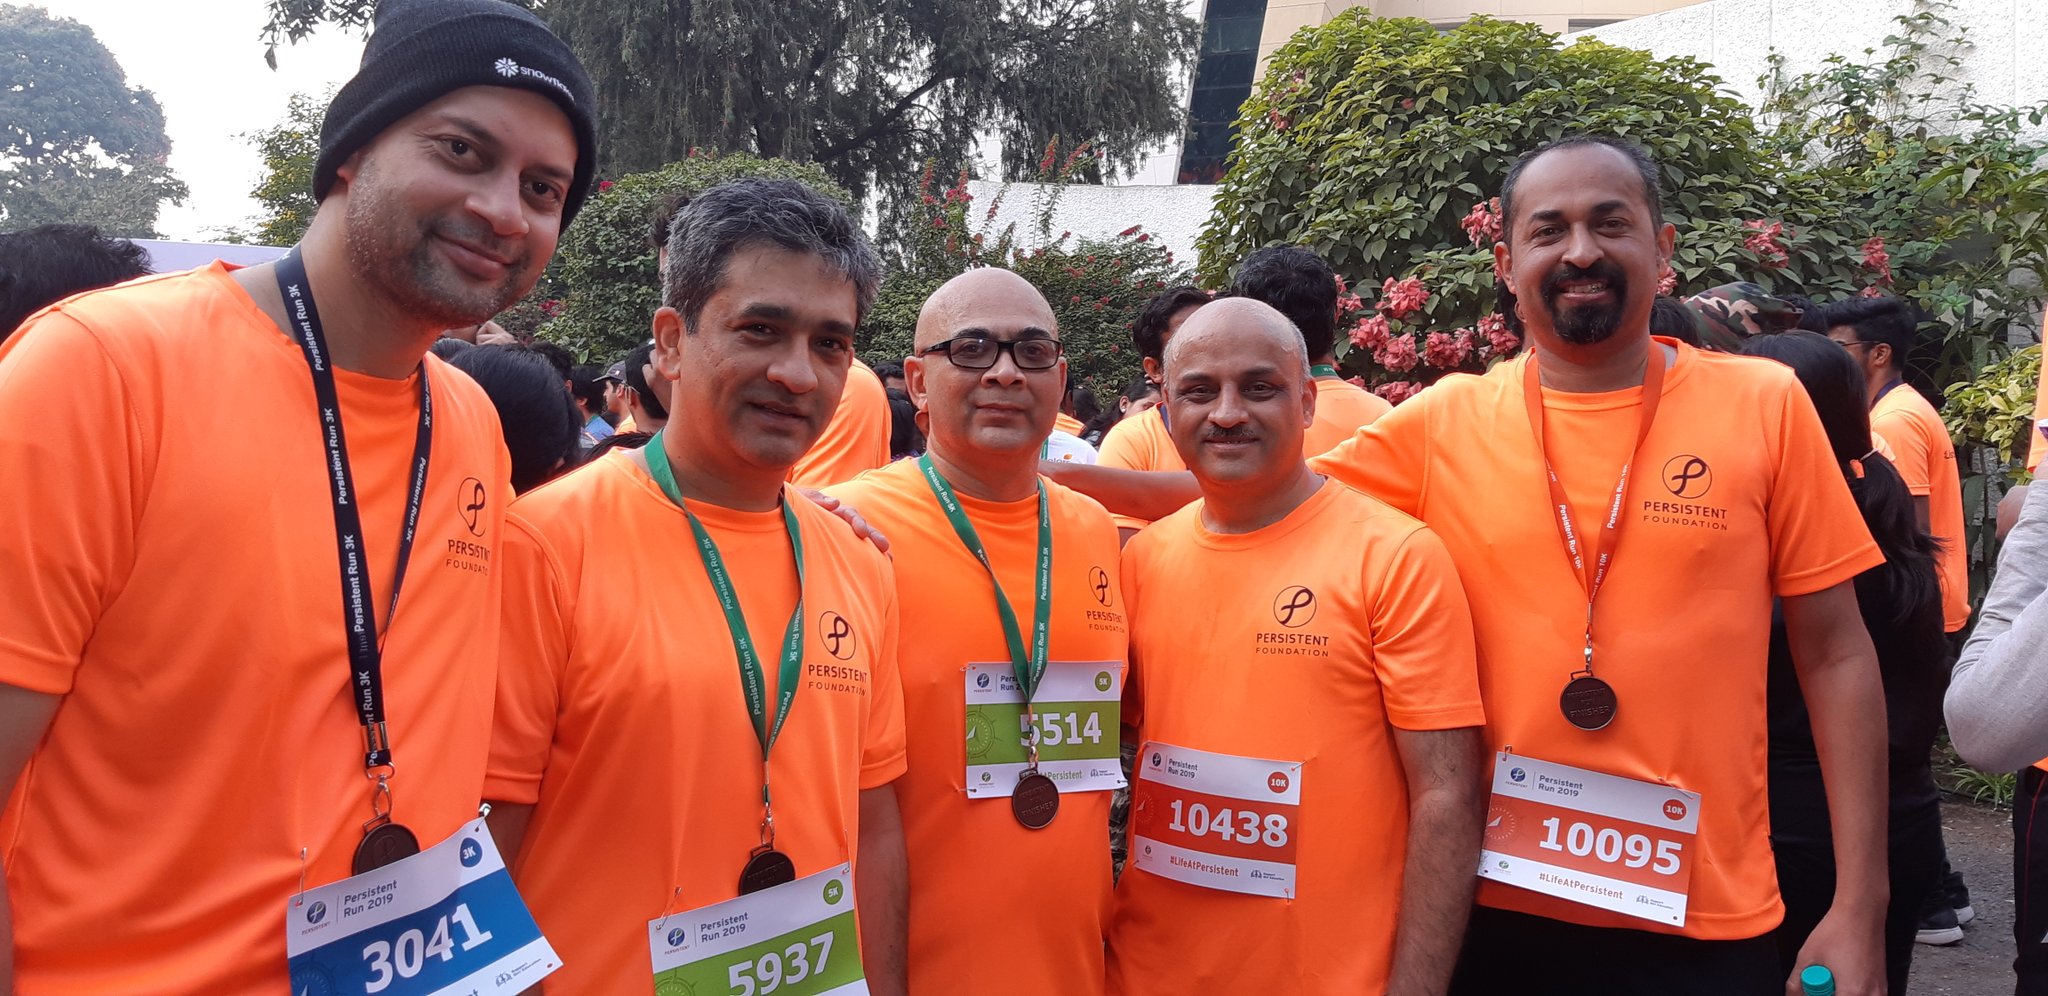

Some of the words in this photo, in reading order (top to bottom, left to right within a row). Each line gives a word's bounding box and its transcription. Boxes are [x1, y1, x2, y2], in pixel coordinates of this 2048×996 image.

[520, 66, 576, 105] snowfla
[287, 284, 301, 298] 3K
[297, 299, 310, 320] Run
[301, 321, 325, 371] Persistent
[325, 408, 336, 423] 3K
[328, 425, 339, 447] Run
[330, 448, 348, 505] Persistent
[412, 457, 427, 505] Persistent
[409, 505, 418, 526] Run
[1607, 492, 1622, 529] Persistent
[1644, 501, 1728, 519] PERSISTENT
[1559, 504, 1574, 540] Persistent
[1568, 539, 1577, 555] Run
[1643, 515, 1728, 531] FOUNDATION
[344, 534, 356, 551] 3K
[406, 527, 413, 543] 3K
[702, 538, 712, 549] 5K
[348, 552, 360, 576] Run
[709, 547, 719, 567] Run
[714, 565, 733, 610] Persistent
[352, 579, 365, 633] Persistent
[739, 637, 747, 650] 5K
[791, 633, 799, 650] Run
[1256, 633, 1329, 646] PERSISTENT
[743, 650, 753, 671] Run
[789, 651, 797, 662] 5K
[1255, 647, 1329, 657] FOUNDATION
[359, 671, 371, 686] 3K
[808, 664, 868, 683] PERSISTENT
[363, 688, 374, 711] Run
[746, 670, 761, 715] Persistent
[1020, 711, 1102, 747] 5514
[1168, 766, 1179, 775] Run
[1180, 769, 1196, 778] 2019
[1169, 758, 1198, 771] Persistent
[1271, 778, 1286, 787] 10K
[1538, 783, 1555, 793] Run
[1557, 787, 1579, 797] 2019
[1539, 775, 1583, 790] Persistent
[1666, 805, 1683, 815] 10K
[1169, 799, 1288, 847] 10438
[463, 846, 476, 859] 3K
[1539, 816, 1682, 875] 10095
[1170, 856, 1239, 877] #LifeAtPersistent
[344, 880, 397, 905] Persistent
[828, 887, 839, 897] 5K
[1539, 873, 1623, 900] #LifeAtPersistent
[344, 903, 364, 918] Run
[368, 894, 393, 912] 2019
[700, 912, 748, 932] Persistent
[701, 929, 720, 943] Run
[723, 923, 746, 938] 2019
[363, 903, 492, 994] 3041
[729, 931, 834, 996] 5937
